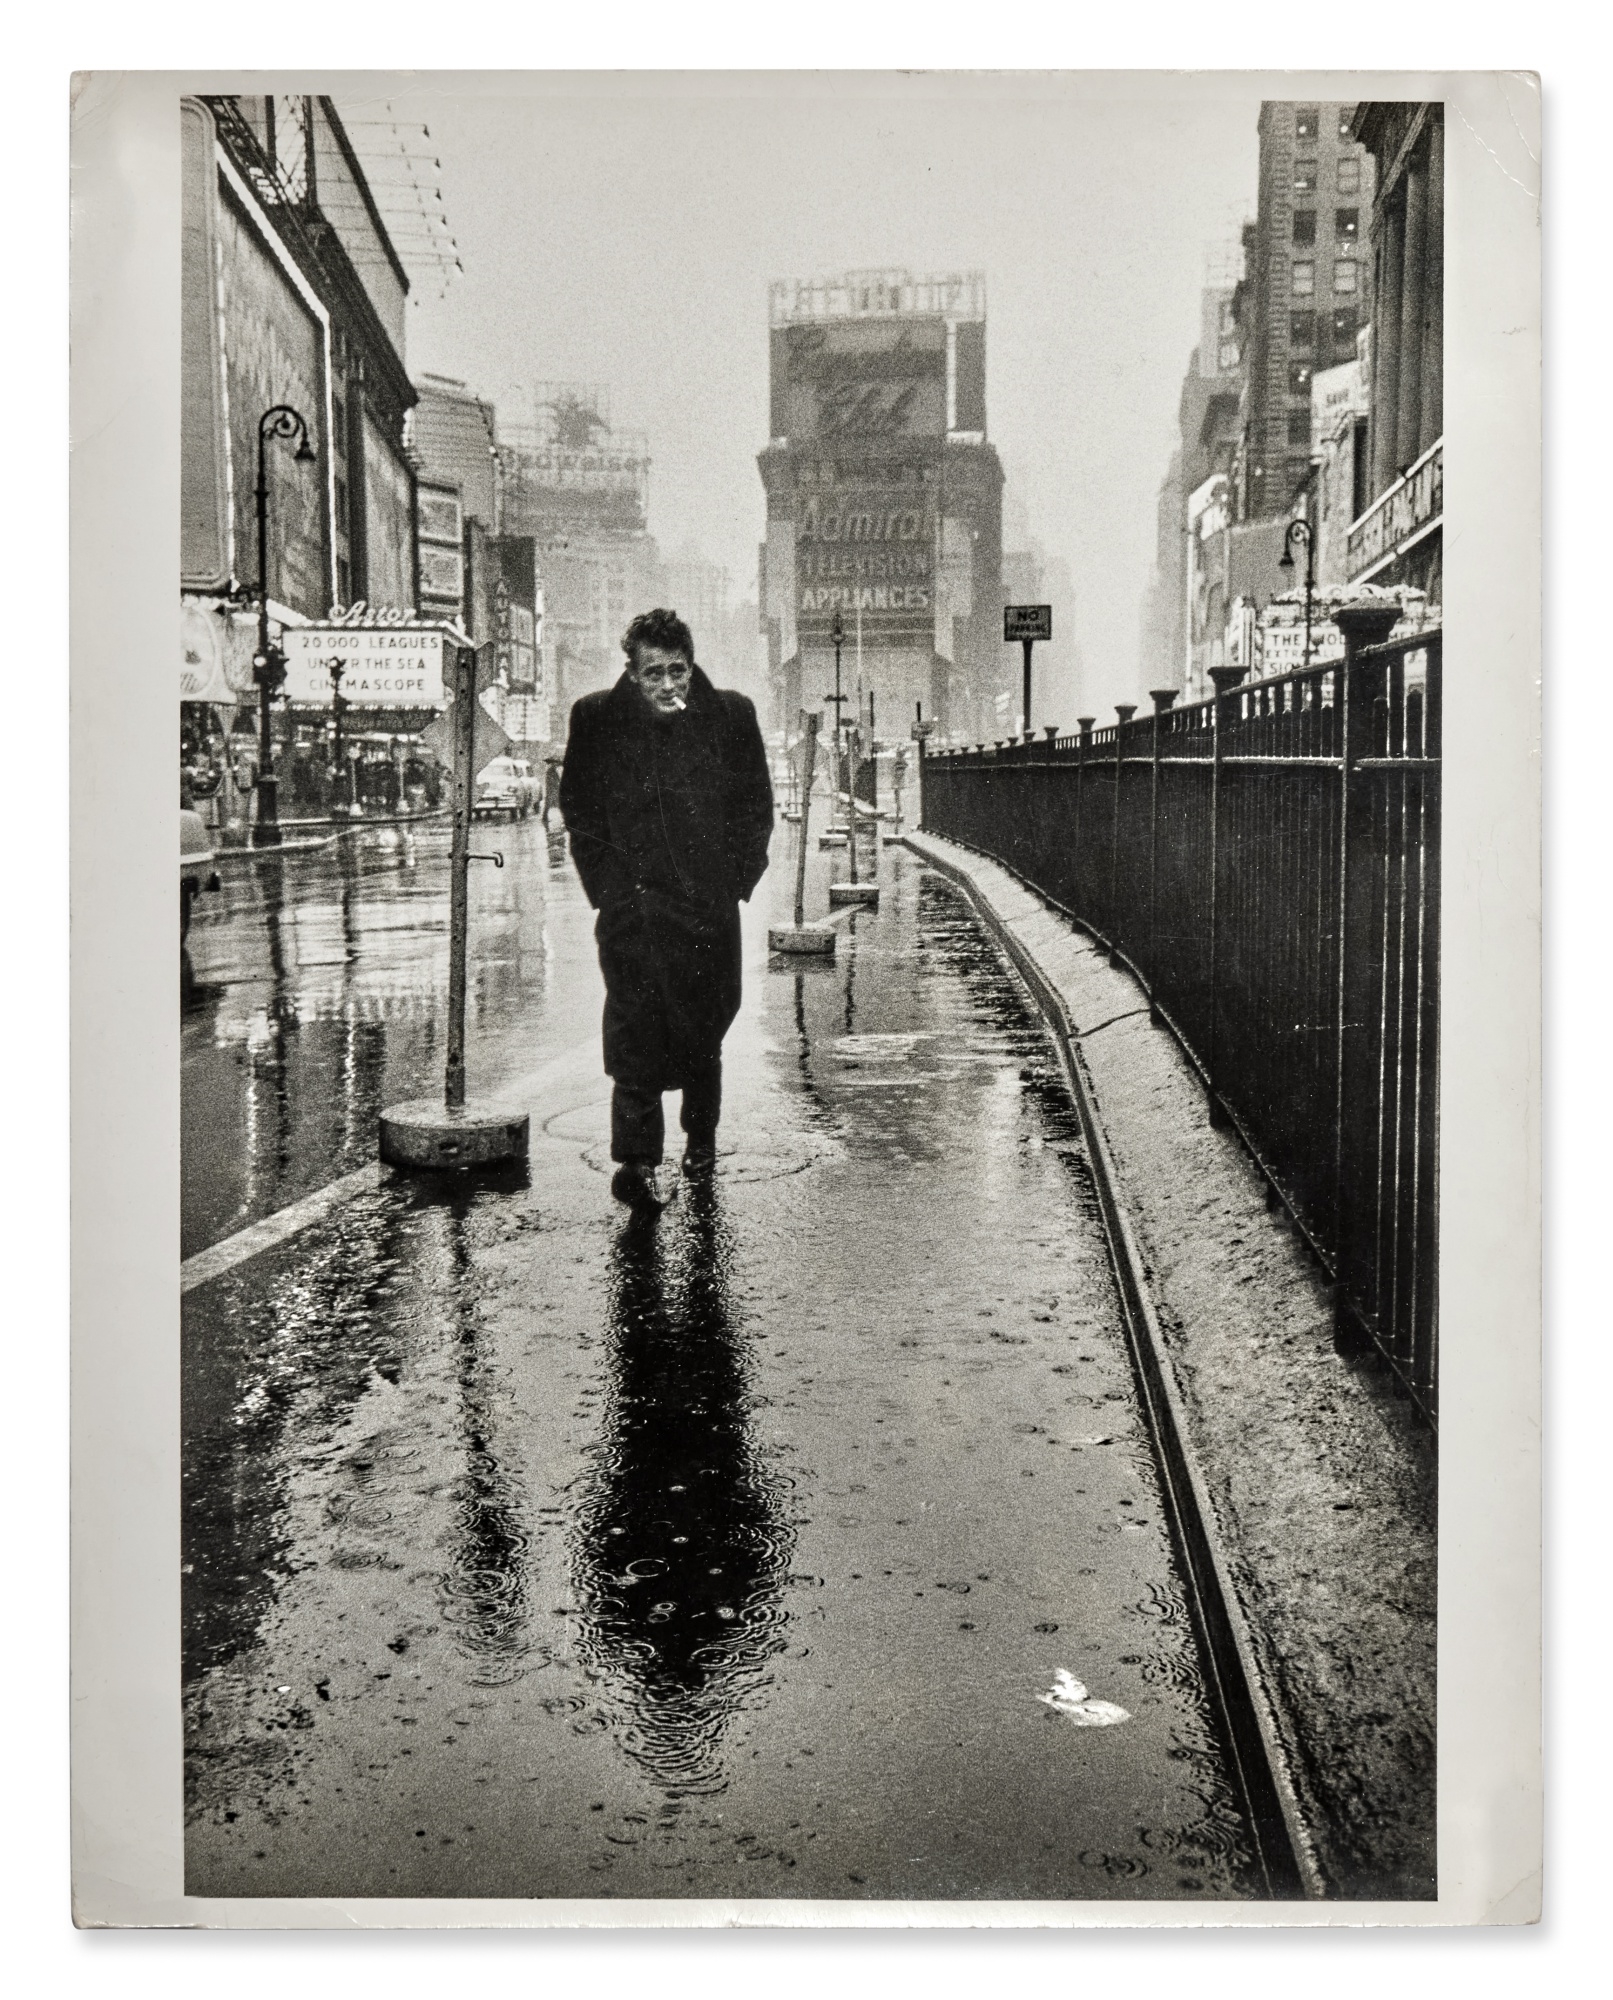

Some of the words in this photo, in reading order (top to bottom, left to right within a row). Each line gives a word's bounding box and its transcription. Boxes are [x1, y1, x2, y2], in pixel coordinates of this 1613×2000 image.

[802, 553, 929, 577] TELEVISION
[802, 585, 930, 610] APPLIANCES
[329, 600, 417, 623] Astor
[1017, 610, 1039, 621] NO
[302, 636, 322, 649] 20
[327, 636, 360, 649] 000
[369, 636, 439, 649] LEAGUES
[1272, 633, 1301, 646] THE
[308, 657, 360, 669] UNR
[365, 657, 391, 669] THE
[398, 657, 425, 669] SEA
[309, 678, 425, 690] CINMASCOPE
